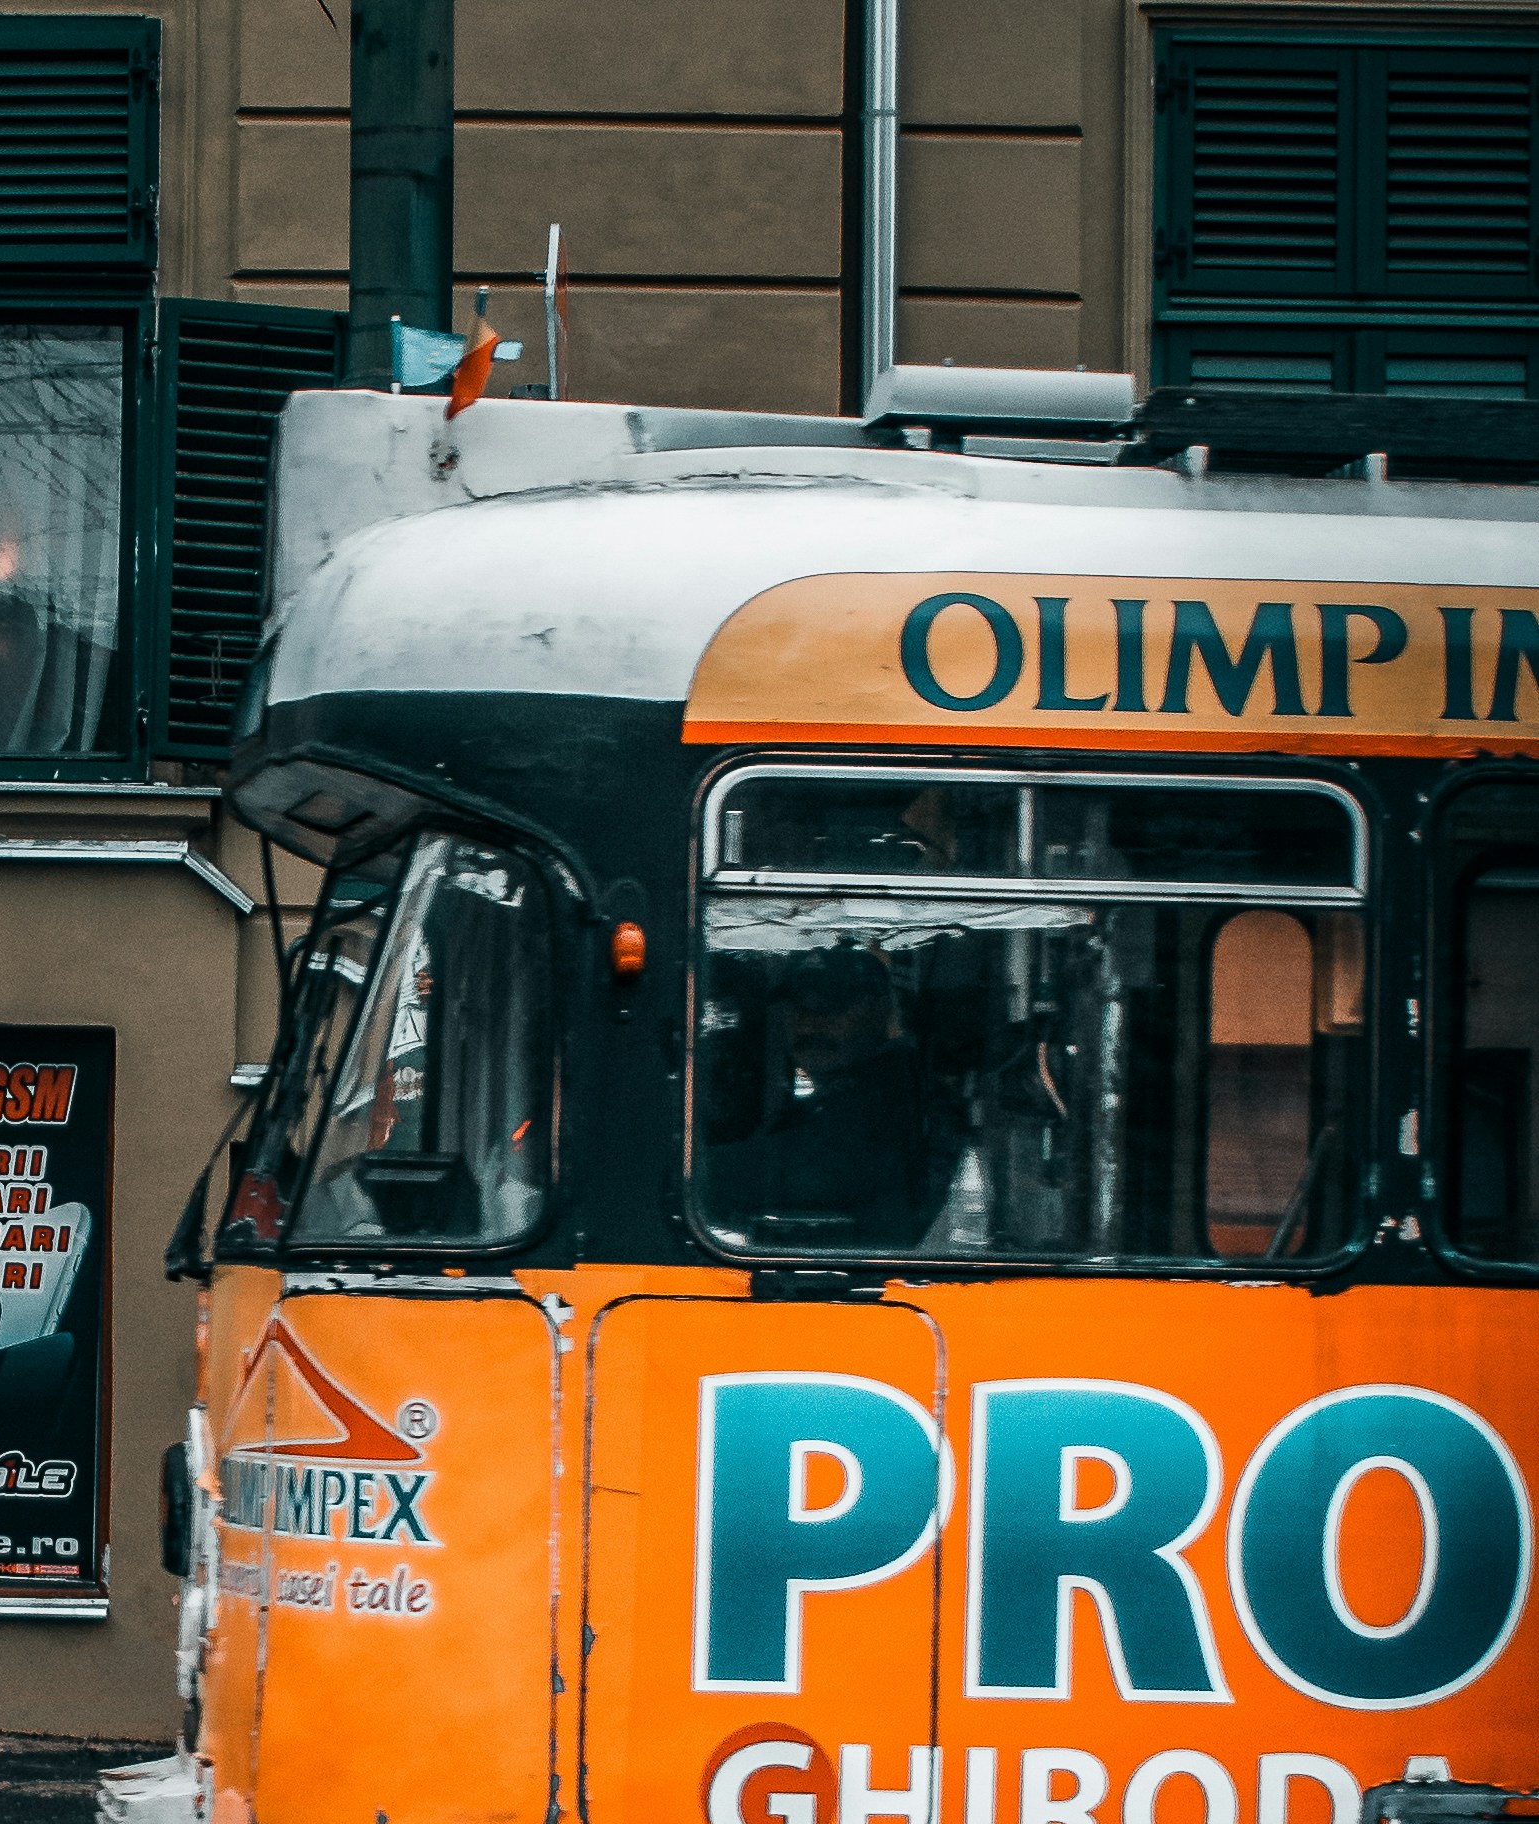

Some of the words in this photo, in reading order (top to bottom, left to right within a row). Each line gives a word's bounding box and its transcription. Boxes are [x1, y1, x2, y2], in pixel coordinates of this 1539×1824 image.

[900, 592, 1408, 719] OLIMP
[347, 1566, 431, 1616] tale
[692, 1371, 1533, 1711] PRO
